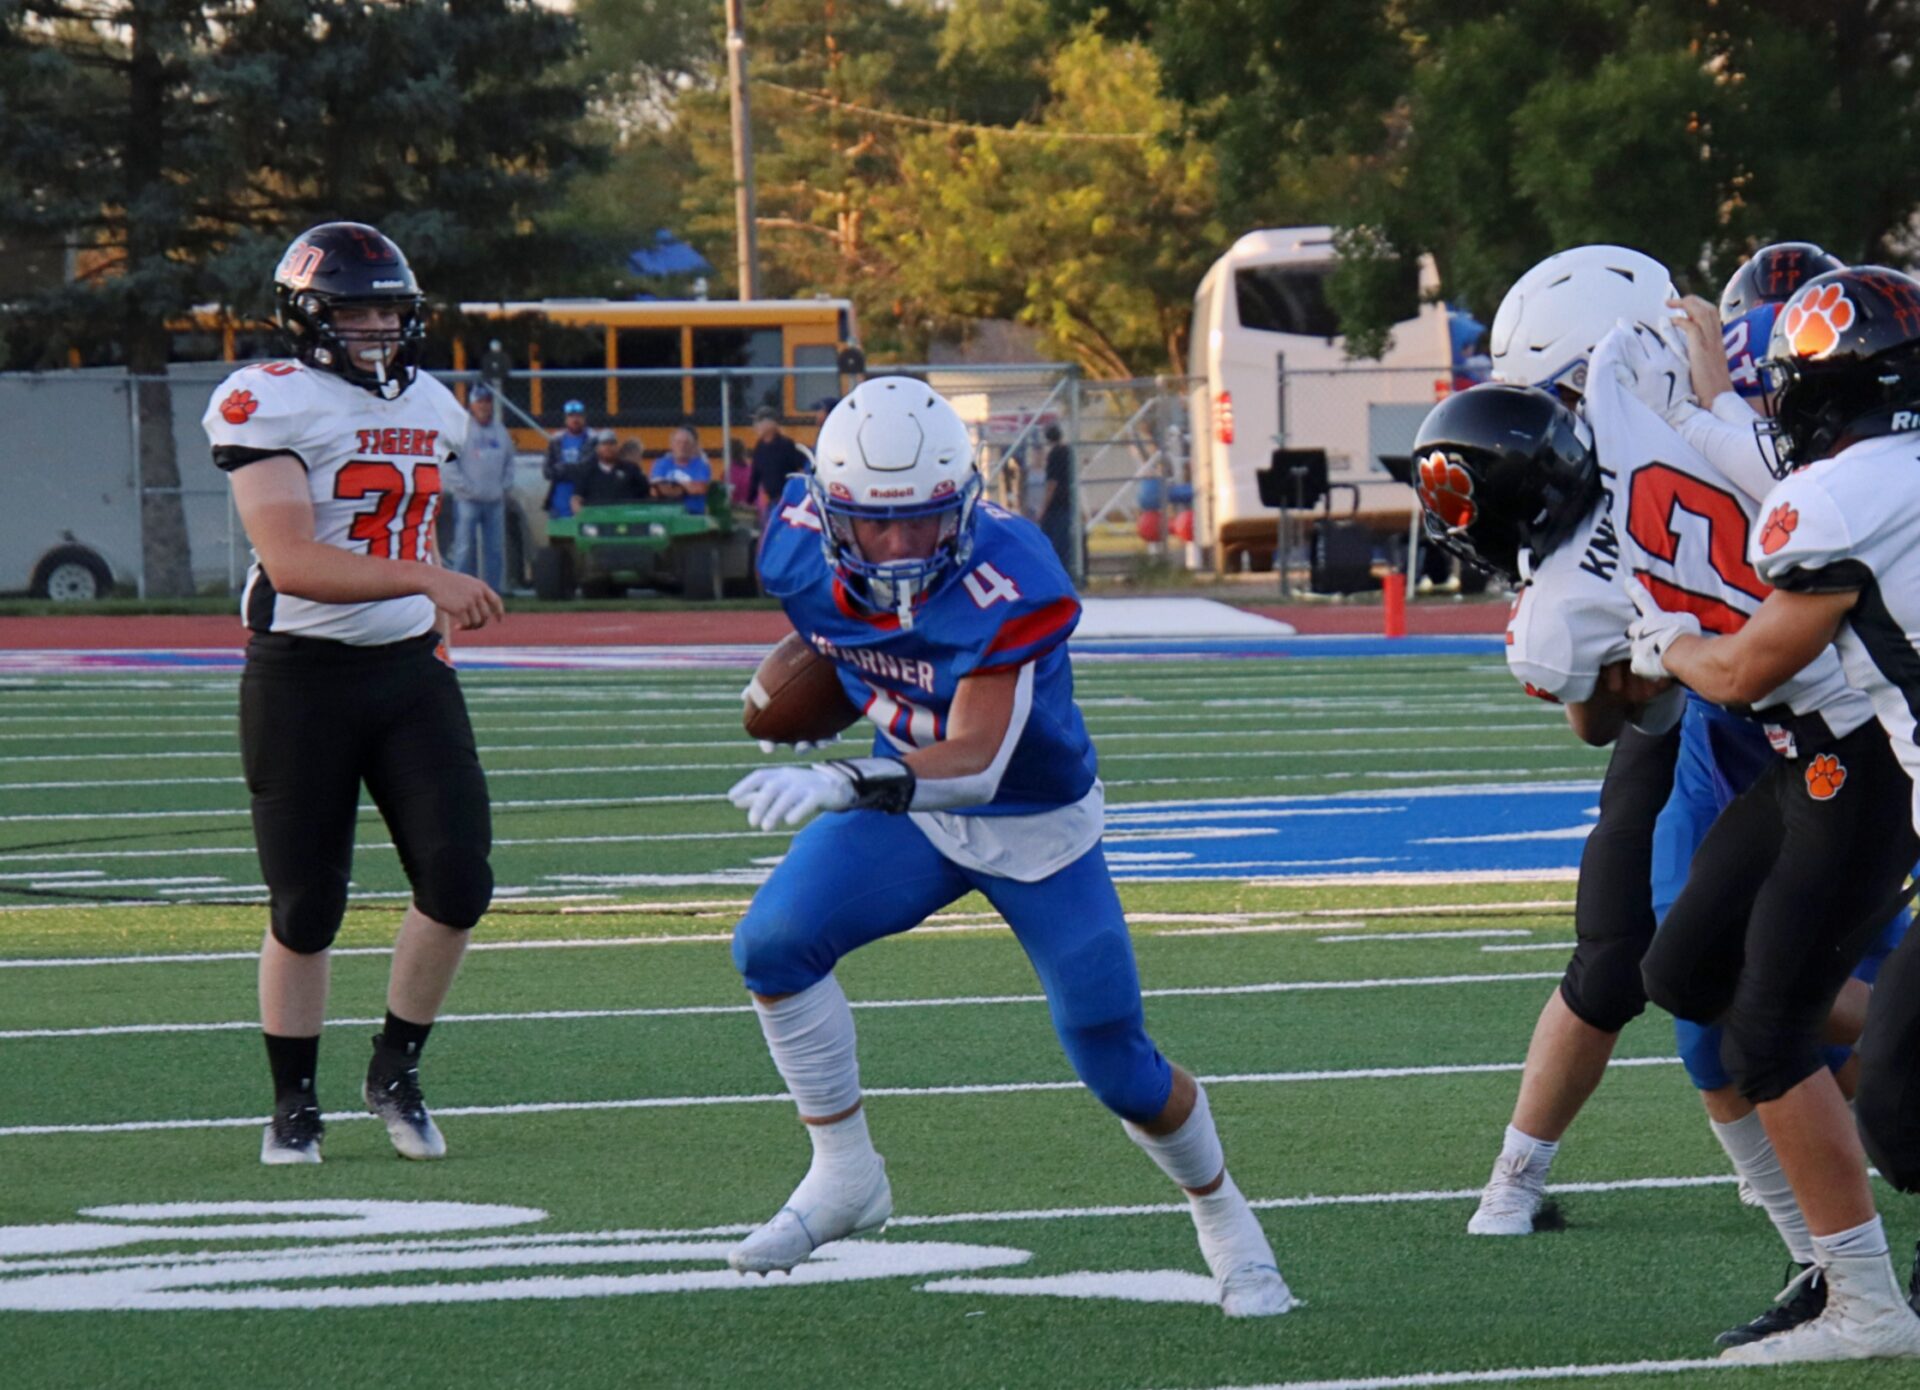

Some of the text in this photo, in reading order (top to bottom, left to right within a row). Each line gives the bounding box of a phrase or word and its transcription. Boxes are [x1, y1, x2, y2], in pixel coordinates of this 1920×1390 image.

[355, 428, 439, 456] TIGERS
[869, 486, 915, 499] Riddell
[961, 560, 1024, 610] 4
